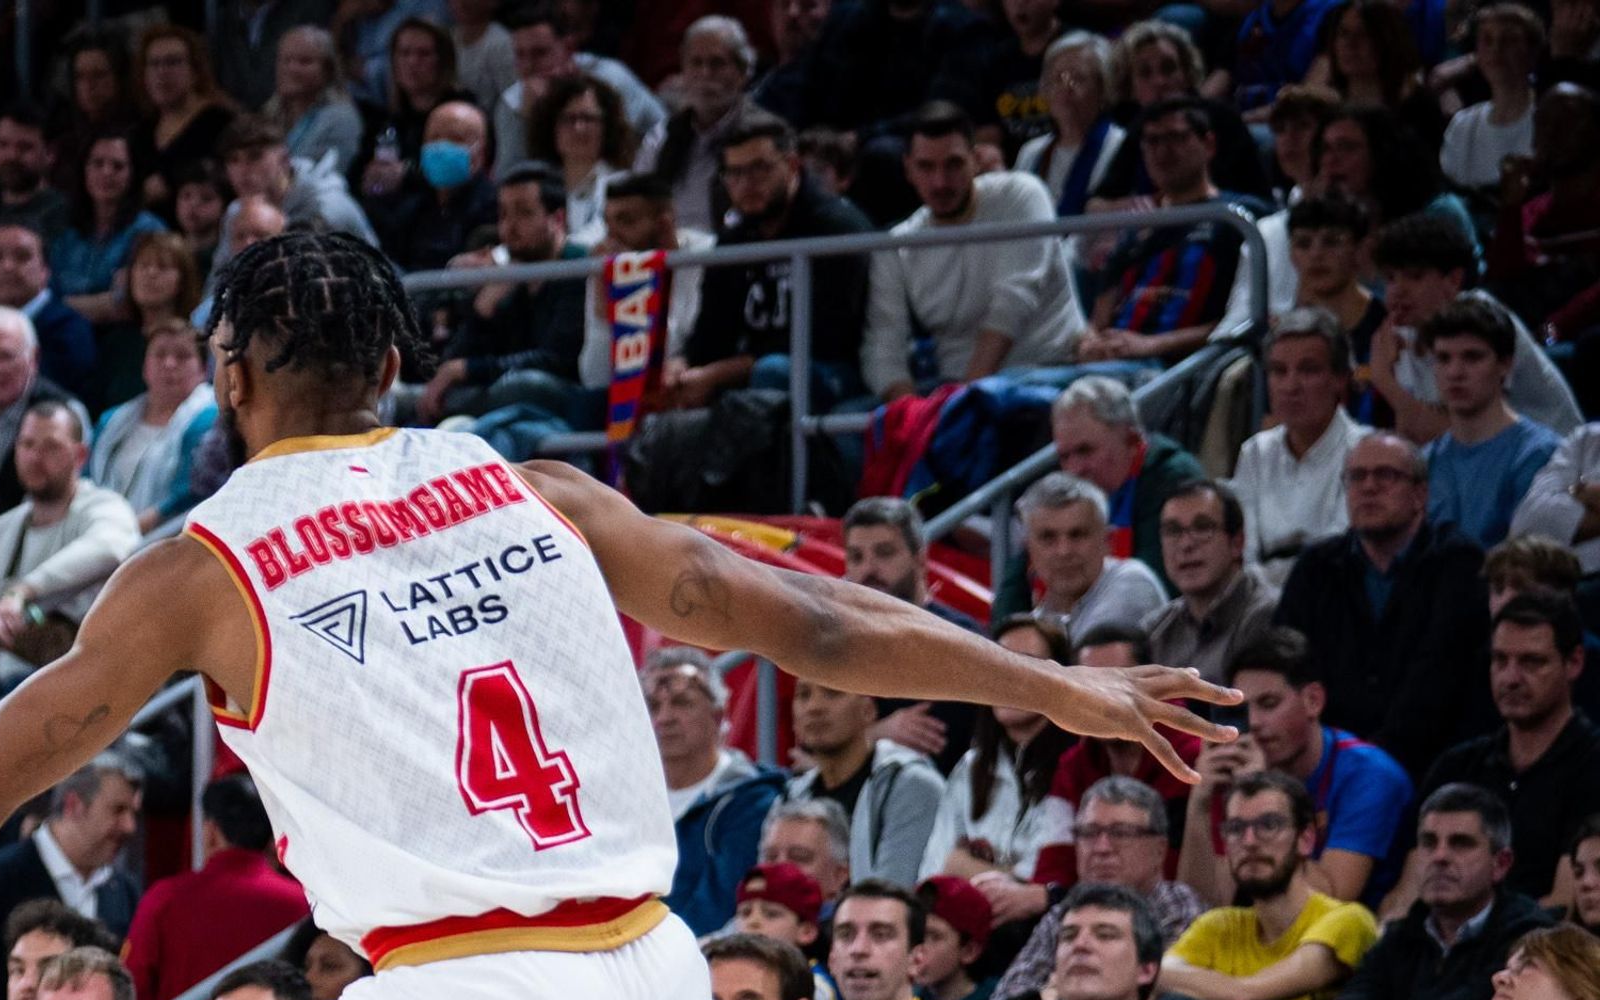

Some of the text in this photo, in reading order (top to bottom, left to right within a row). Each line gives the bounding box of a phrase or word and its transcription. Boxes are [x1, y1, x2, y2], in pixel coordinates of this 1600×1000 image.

[246, 459, 528, 592] BLOSSOMGAME
[379, 533, 563, 613] LATTICE
[400, 594, 510, 646] LABS
[454, 658, 593, 853] 4
